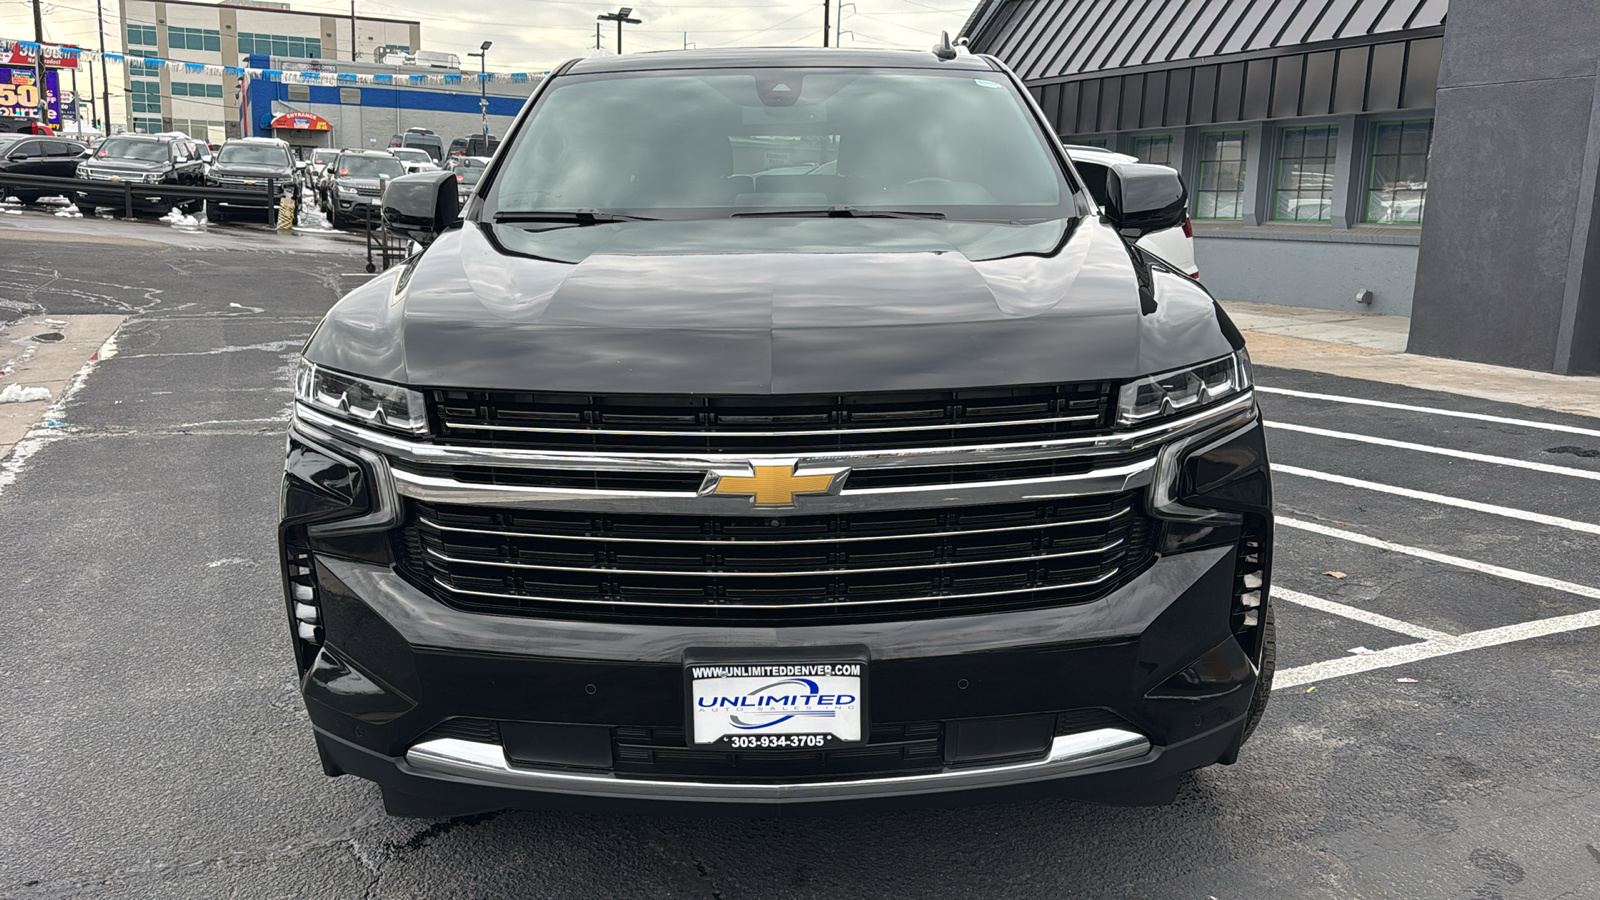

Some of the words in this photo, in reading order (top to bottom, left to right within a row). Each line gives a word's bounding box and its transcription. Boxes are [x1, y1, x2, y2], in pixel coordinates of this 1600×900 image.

[286, 112, 317, 120] ENTRANCE
[692, 665, 861, 678] WWWUNLIMITEDDENVER.COM
[698, 694, 856, 708] UNLIMITED
[731, 735, 824, 748] 303-934-3705
